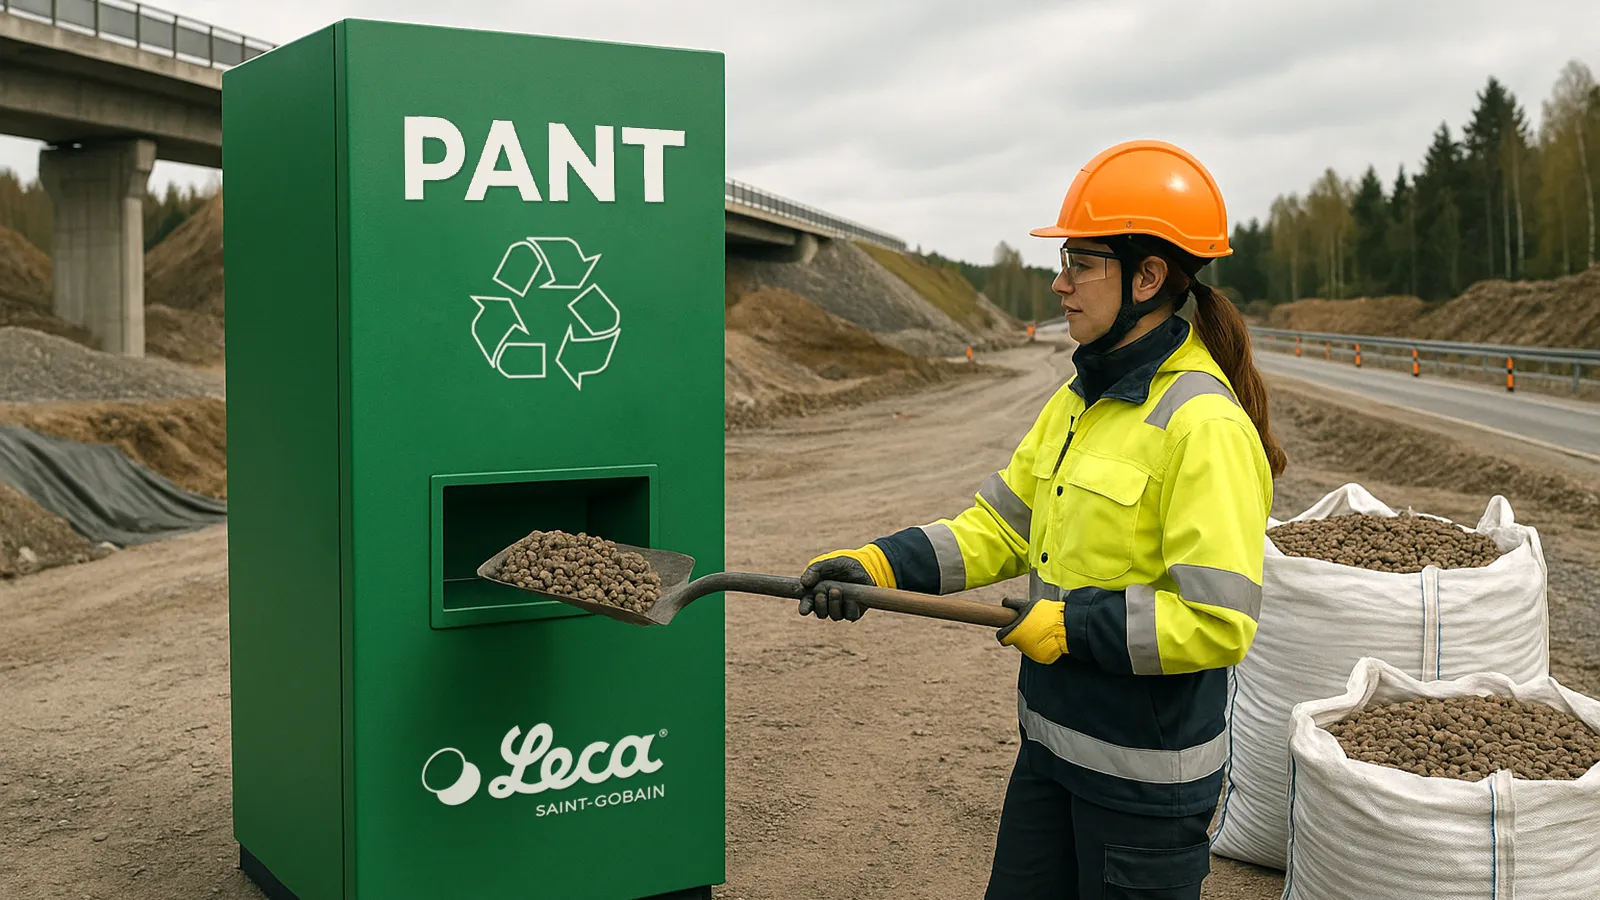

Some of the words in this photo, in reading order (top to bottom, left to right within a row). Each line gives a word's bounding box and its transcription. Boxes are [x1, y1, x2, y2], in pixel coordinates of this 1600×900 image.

[403, 115, 686, 203] PANT
[488, 722, 664, 799] Leca
[535, 784, 665, 817] SAINT-GOBAIN
